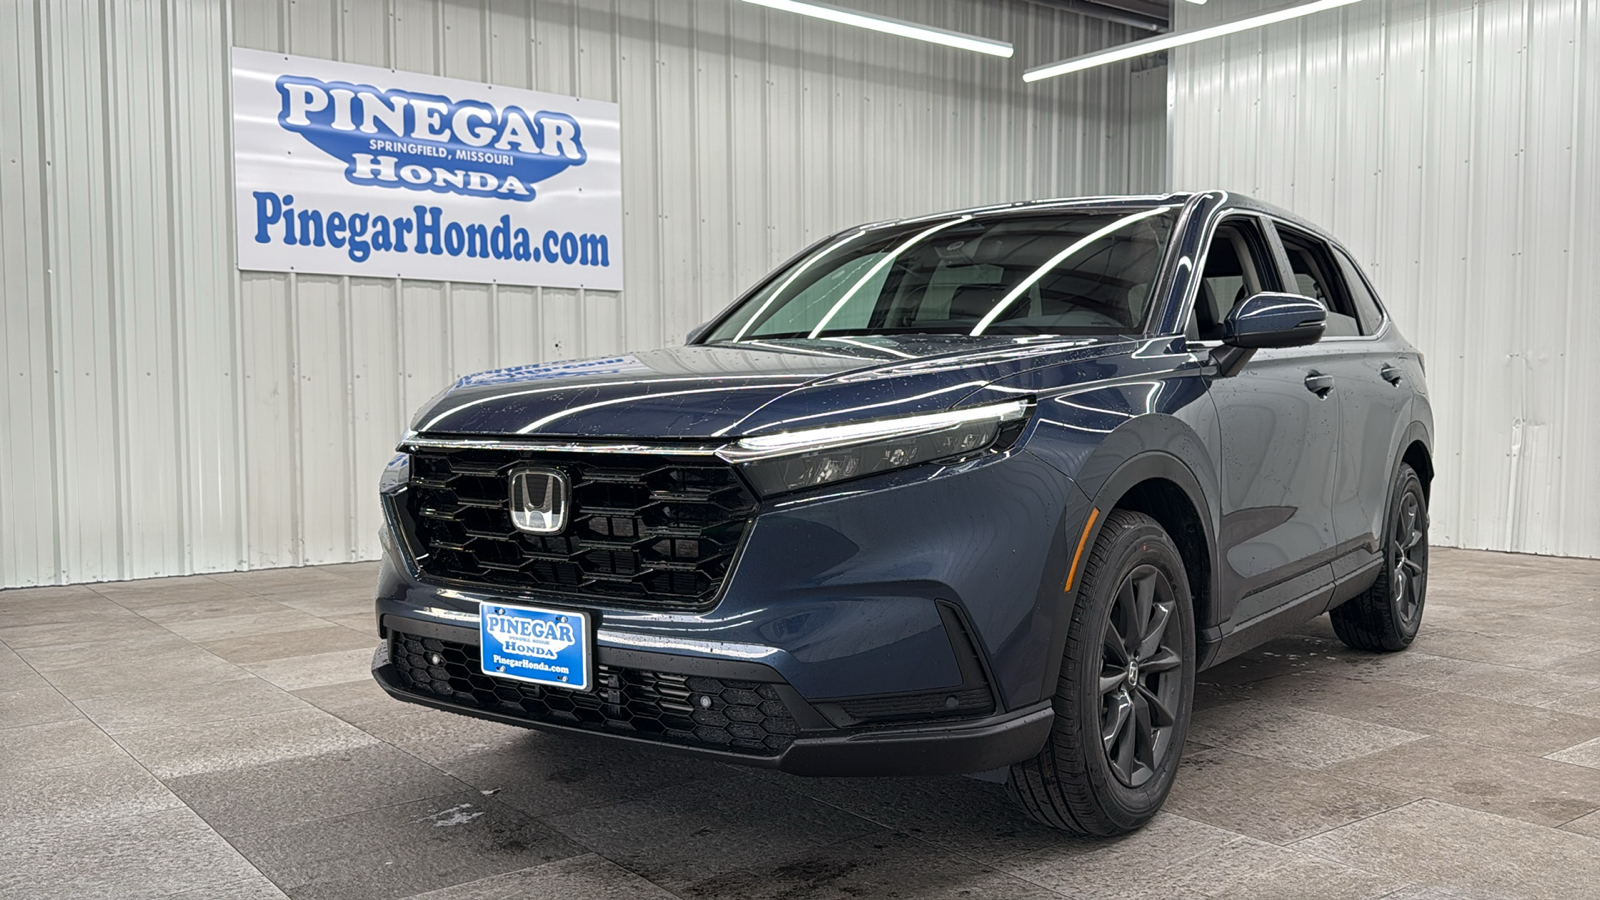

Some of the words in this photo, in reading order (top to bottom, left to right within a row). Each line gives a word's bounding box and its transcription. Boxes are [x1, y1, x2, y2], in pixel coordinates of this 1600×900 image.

[282, 82, 582, 160] PINEGAR
[369, 138, 453, 161] SPRINGFIELD,
[455, 149, 514, 166] MISSOURI
[350, 152, 531, 196] HONDA
[252, 190, 611, 268] PinegarHonda.com
[488, 616, 573, 643] PINEGAR
[504, 640, 555, 657] HONDA
[492, 654, 570, 675] PinegarHonda.com
